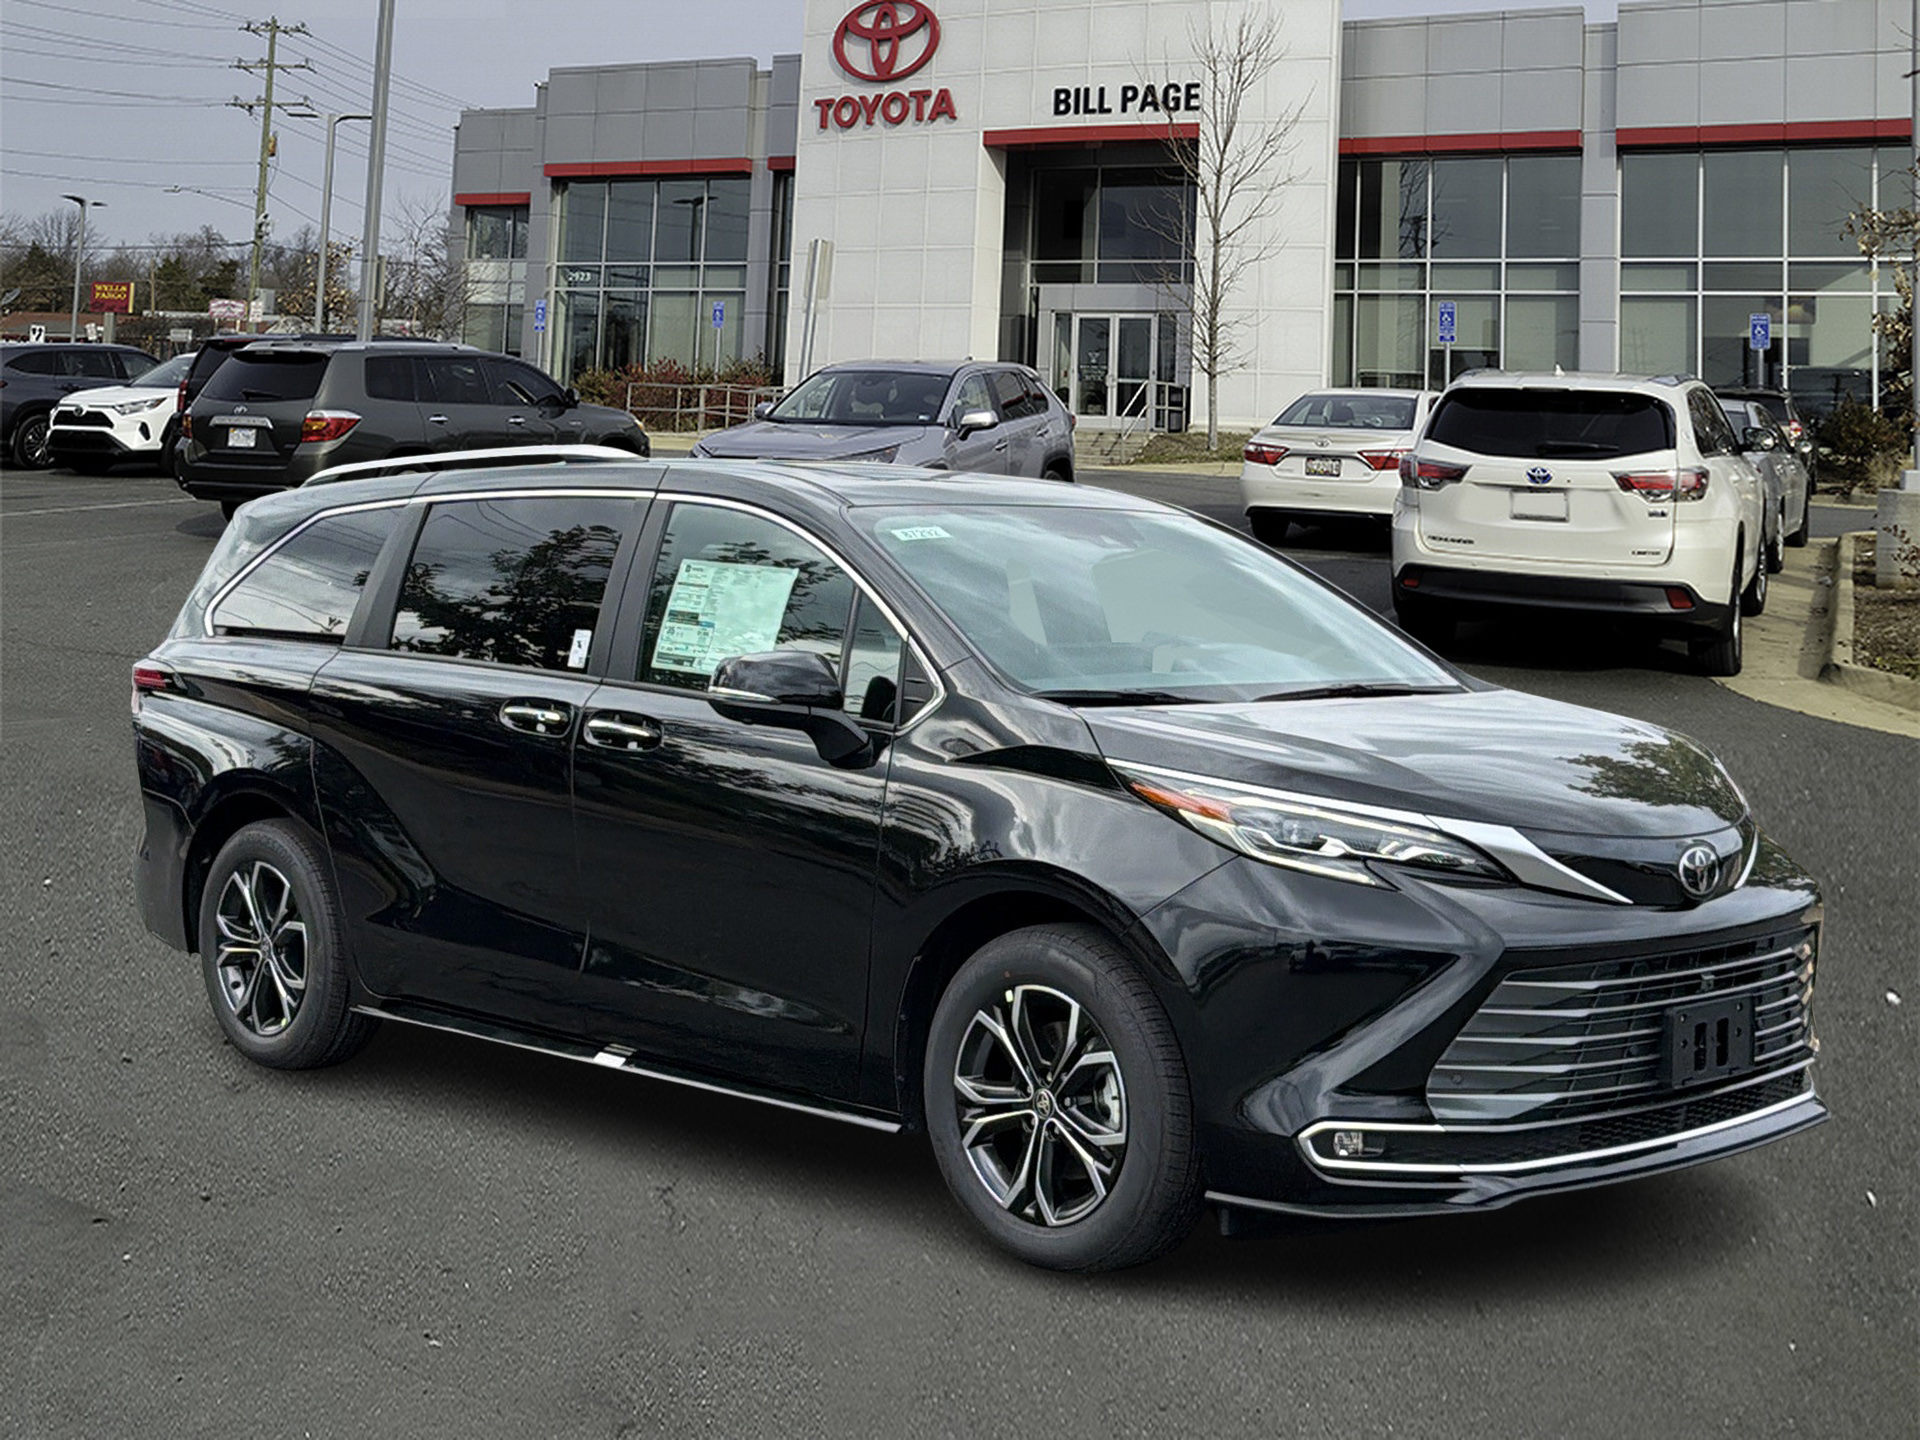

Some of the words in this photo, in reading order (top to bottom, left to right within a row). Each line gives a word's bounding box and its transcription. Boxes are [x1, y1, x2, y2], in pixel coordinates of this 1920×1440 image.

[814, 88, 957, 129] TOYOTA
[1053, 87, 1113, 116] BILL
[1120, 83, 1200, 113] PAGE
[567, 271, 591, 281] 2923
[95, 291, 127, 299] FARGO
